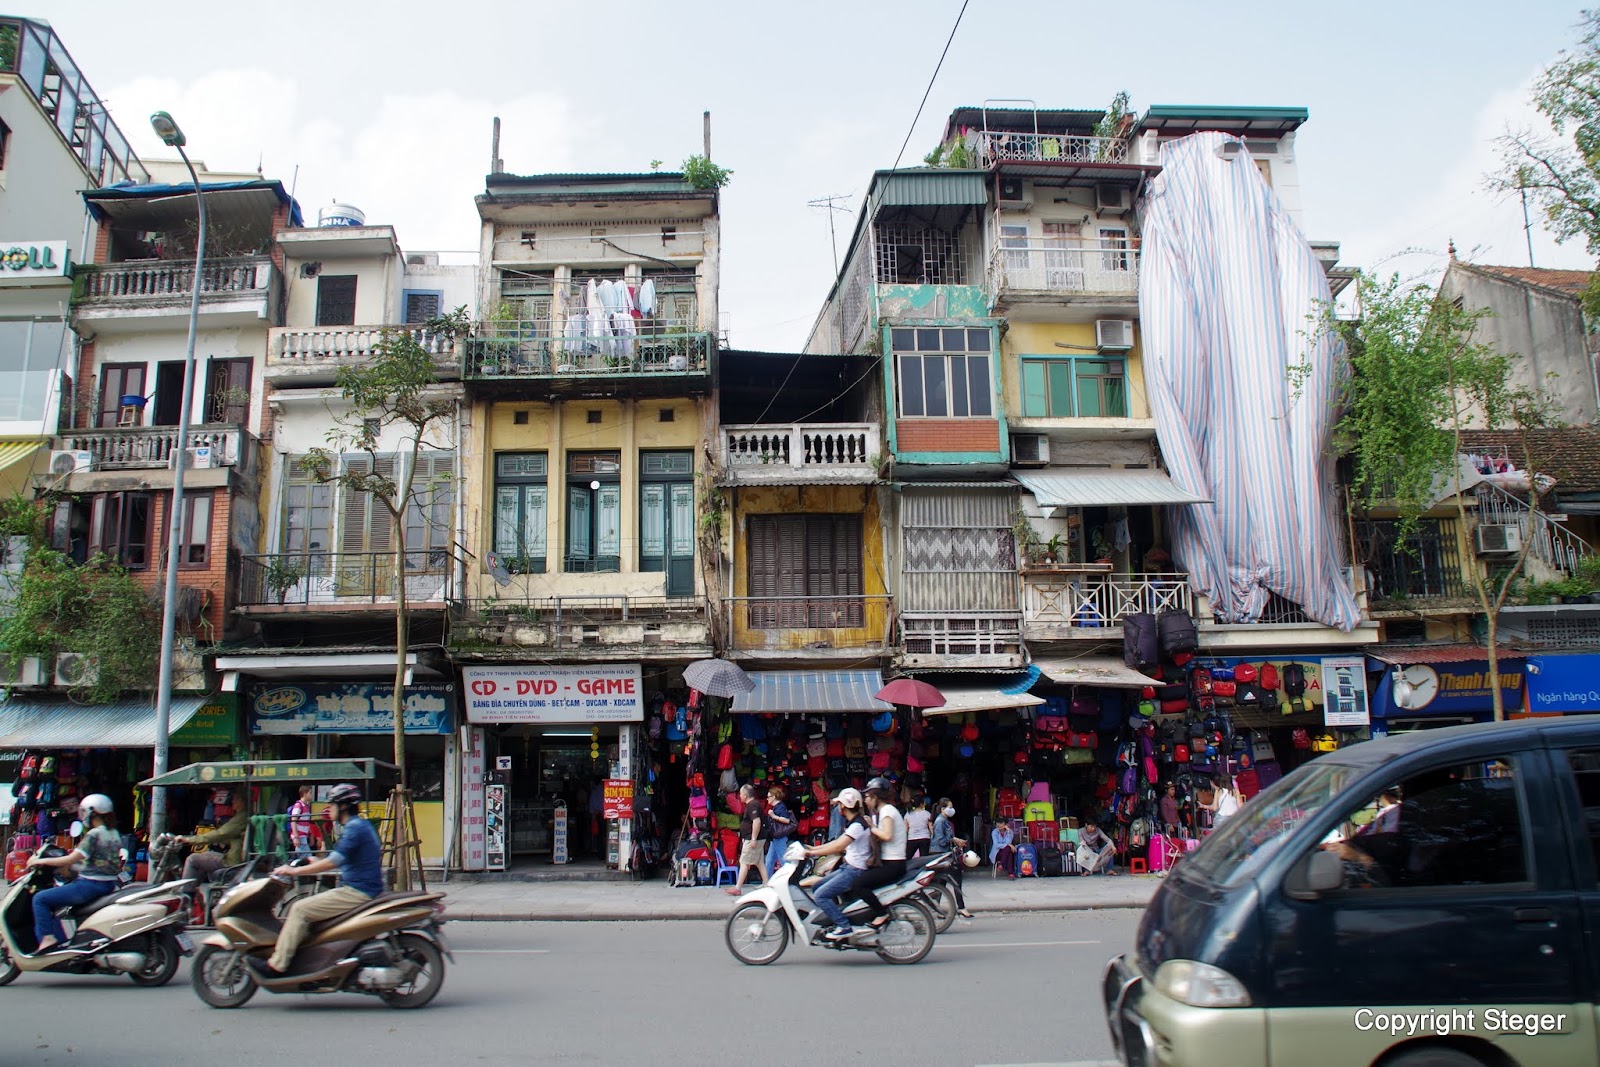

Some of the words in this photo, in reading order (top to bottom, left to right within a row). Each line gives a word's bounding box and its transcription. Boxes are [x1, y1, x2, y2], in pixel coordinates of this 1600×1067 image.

[471, 680, 497, 696] CD
[516, 679, 557, 695] DVD
[577, 678, 636, 696] GAME
[1439, 672, 1482, 690] Thanh
[1484, 672, 1522, 690] Dng
[551, 699, 580, 707] BETCAM
[1537, 692, 1562, 704] Ngân
[1564, 691, 1586, 704] hàng
[604, 787, 618, 798] SIM
